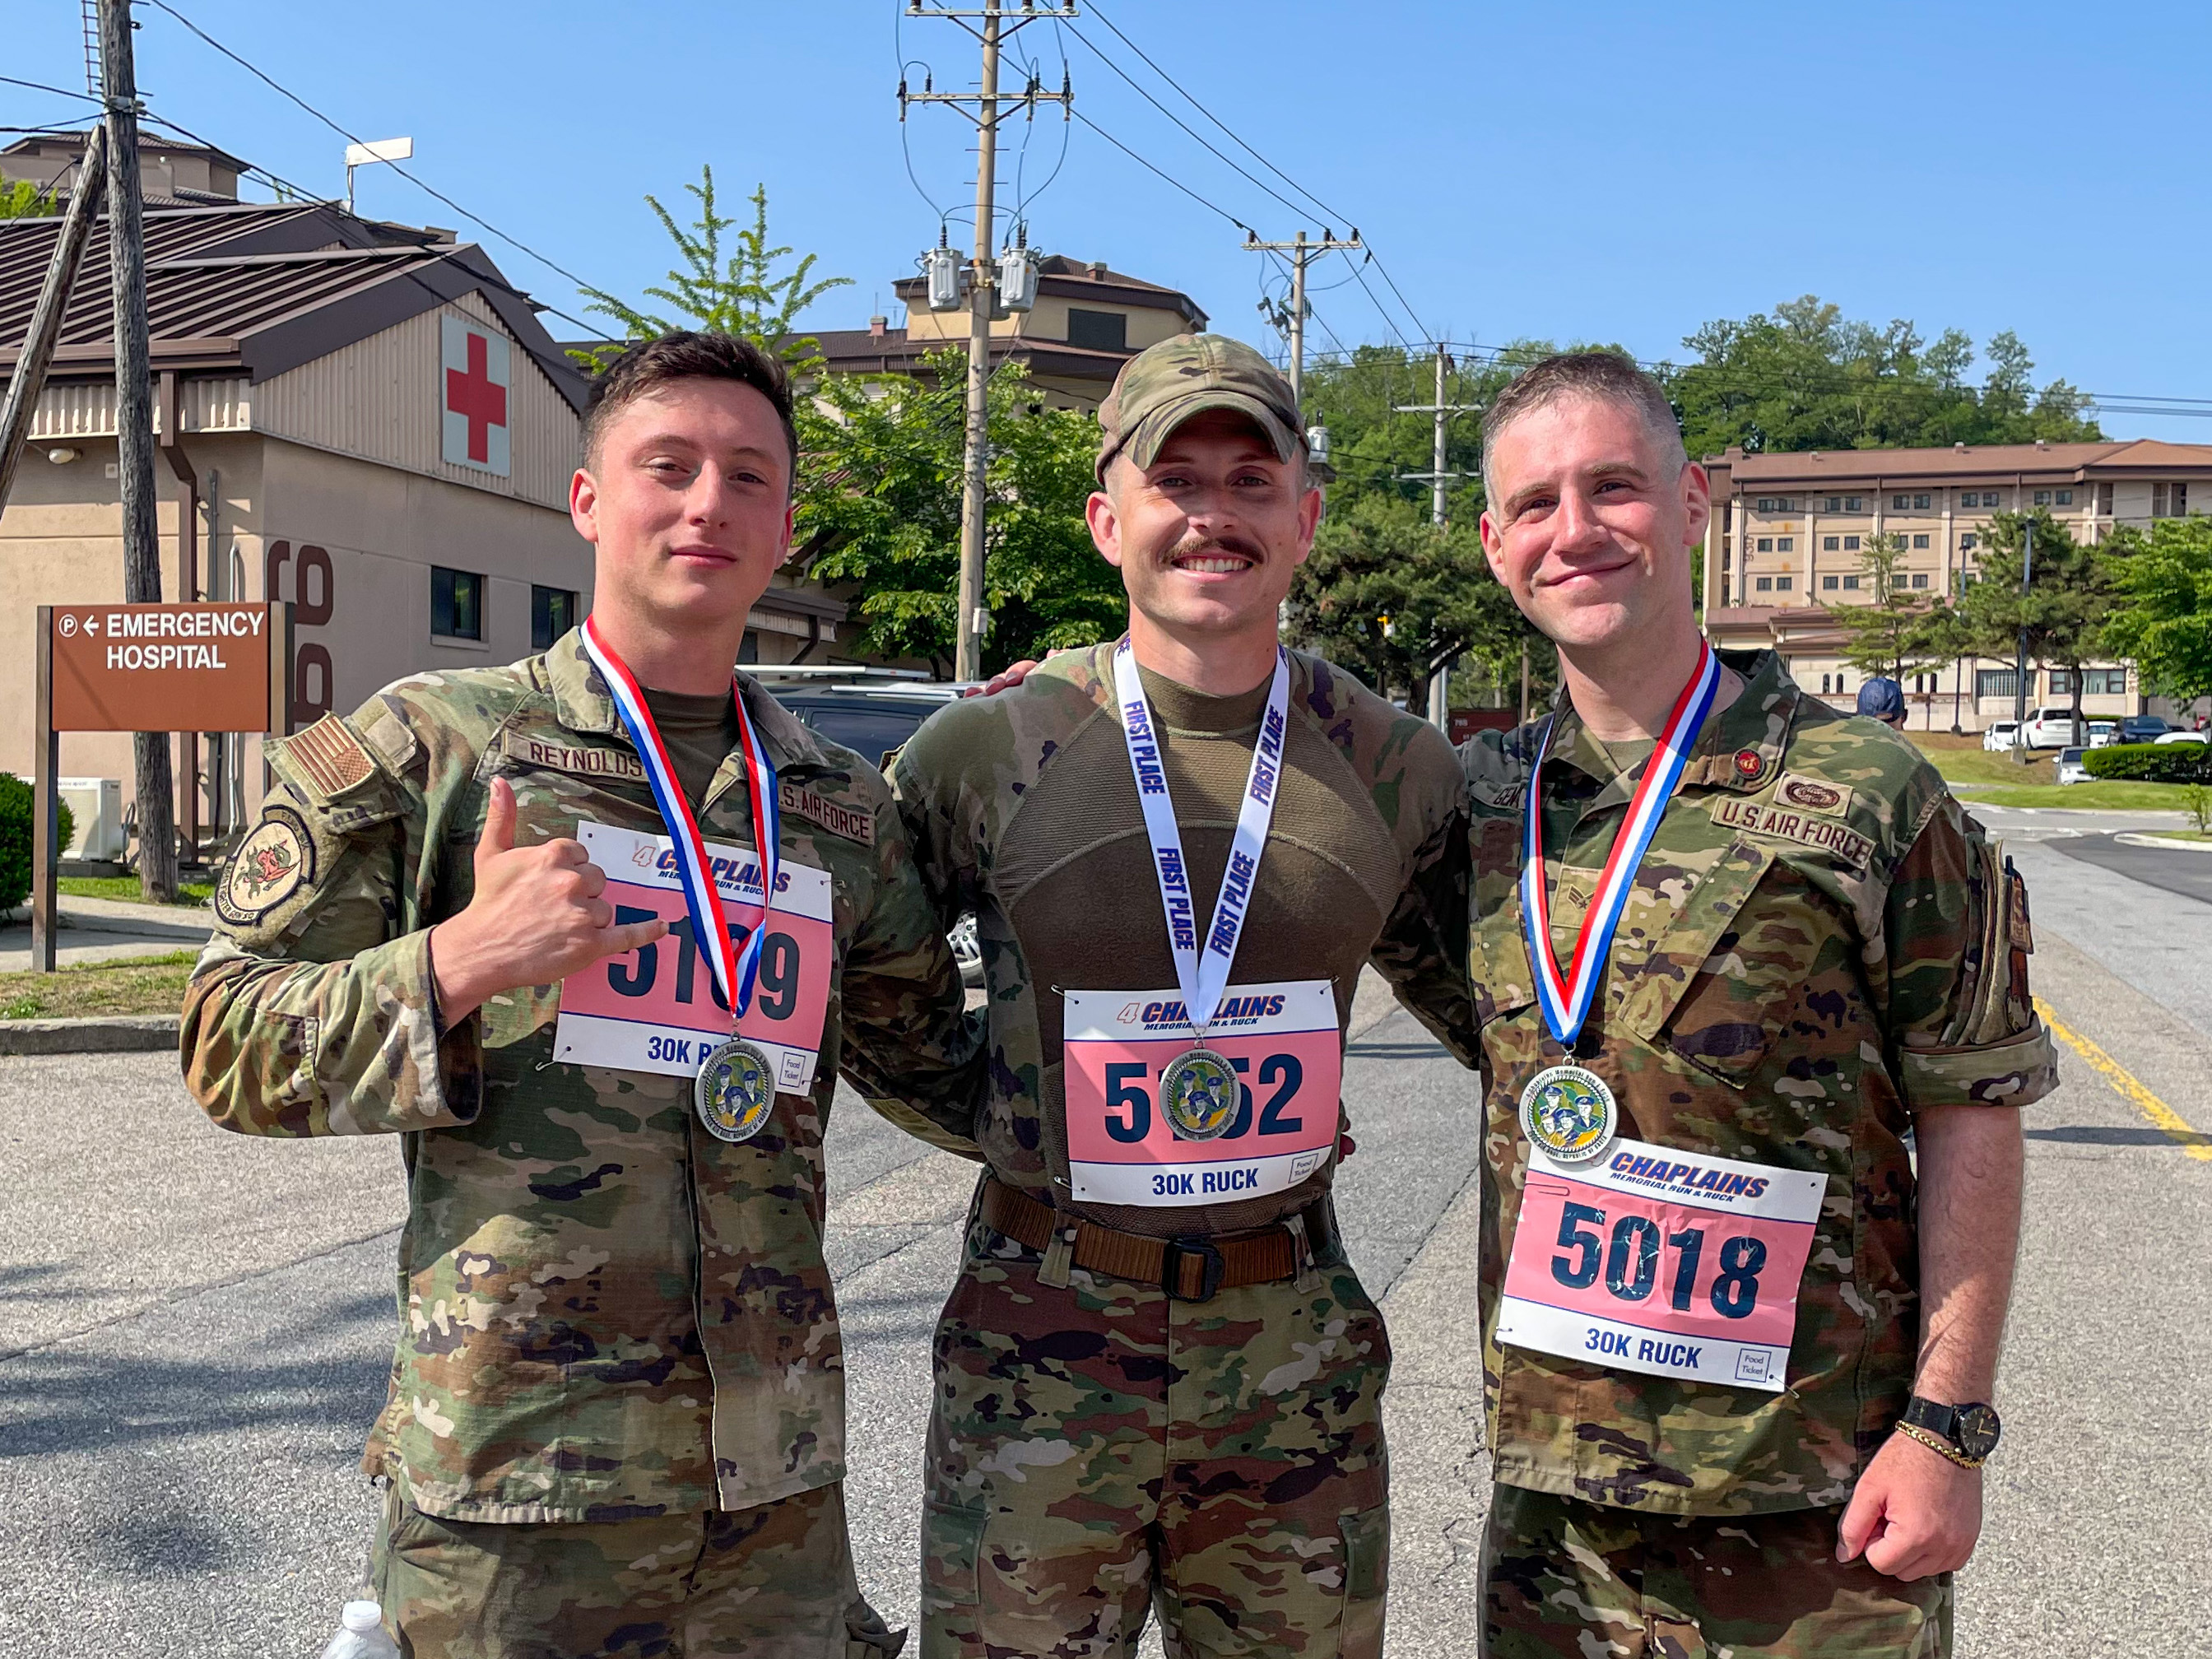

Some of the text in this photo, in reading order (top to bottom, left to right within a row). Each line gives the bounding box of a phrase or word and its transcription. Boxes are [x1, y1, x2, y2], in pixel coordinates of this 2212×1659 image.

[107, 611, 264, 637] EMERGENCY
[107, 645, 226, 669] HOSPITAL
[530, 741, 644, 776] REYNOLDS
[1124, 699, 1165, 795] FIRST PLACE
[1249, 705, 1285, 806] FIRST PLACE
[780, 786, 869, 839] .S. AIR FORCE
[1722, 802, 1870, 864] U.S. AIR FORCE
[632, 845, 791, 893] 4 CPLAIS
[1156, 848, 1195, 950] FIRST PLACE
[1209, 850, 1255, 958] FIRST PLACE
[1116, 994, 1285, 1024] 4 CHALAINS
[1232, 1017, 1259, 1025] RUCK
[648, 1035, 690, 1064] 30K
[787, 1058, 800, 1068] Food
[1104, 1053, 1303, 1143] 552
[1152, 1168, 1259, 1196] 30K RUCK
[1610, 1152, 1769, 1198] CHAPLAINS
[1610, 1172, 1665, 1190] MEMORIAL
[1667, 1184, 1691, 1196] RUN
[1704, 1192, 1736, 1202] RUCK
[1551, 1201, 1767, 1319] 5018
[1585, 1327, 1702, 1369] 30K RUCK
[1745, 1355, 1764, 1364] Food
[1742, 1365, 1763, 1374] Ticket
